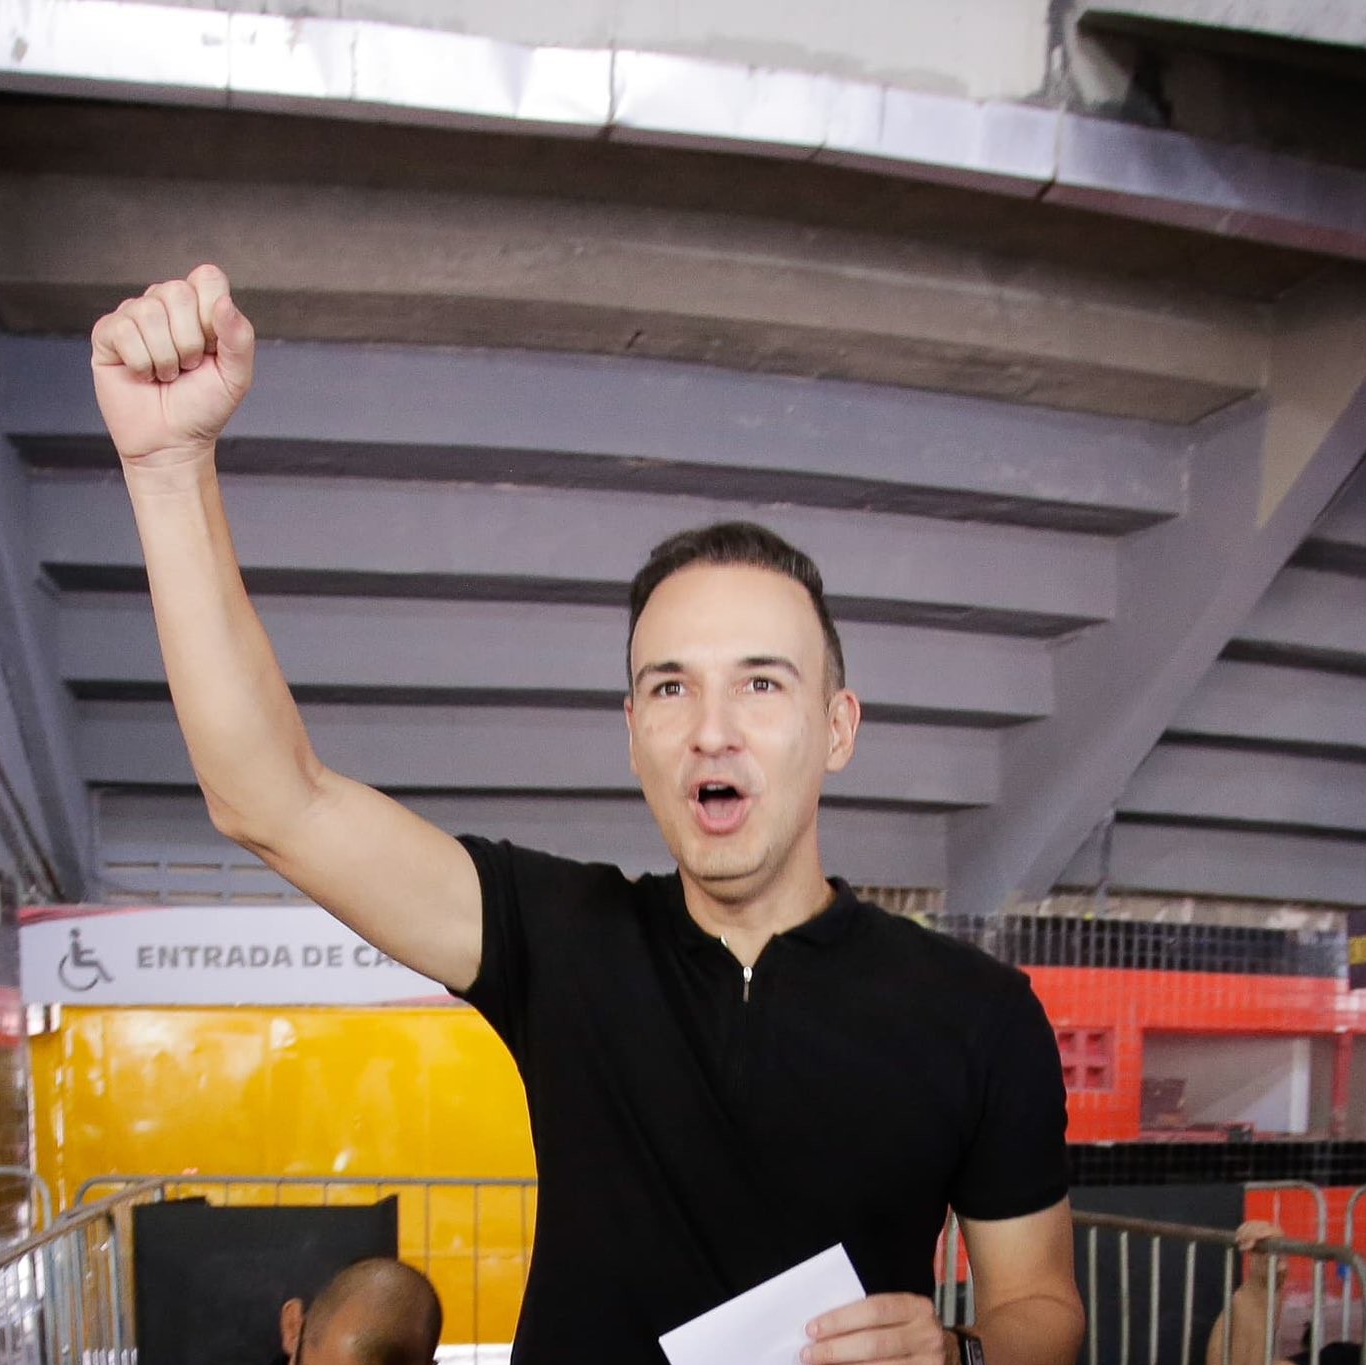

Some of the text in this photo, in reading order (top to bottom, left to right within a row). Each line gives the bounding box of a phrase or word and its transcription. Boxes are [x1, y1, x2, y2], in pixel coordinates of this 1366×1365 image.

[136, 944, 404, 969] ENTRADA DE CA
